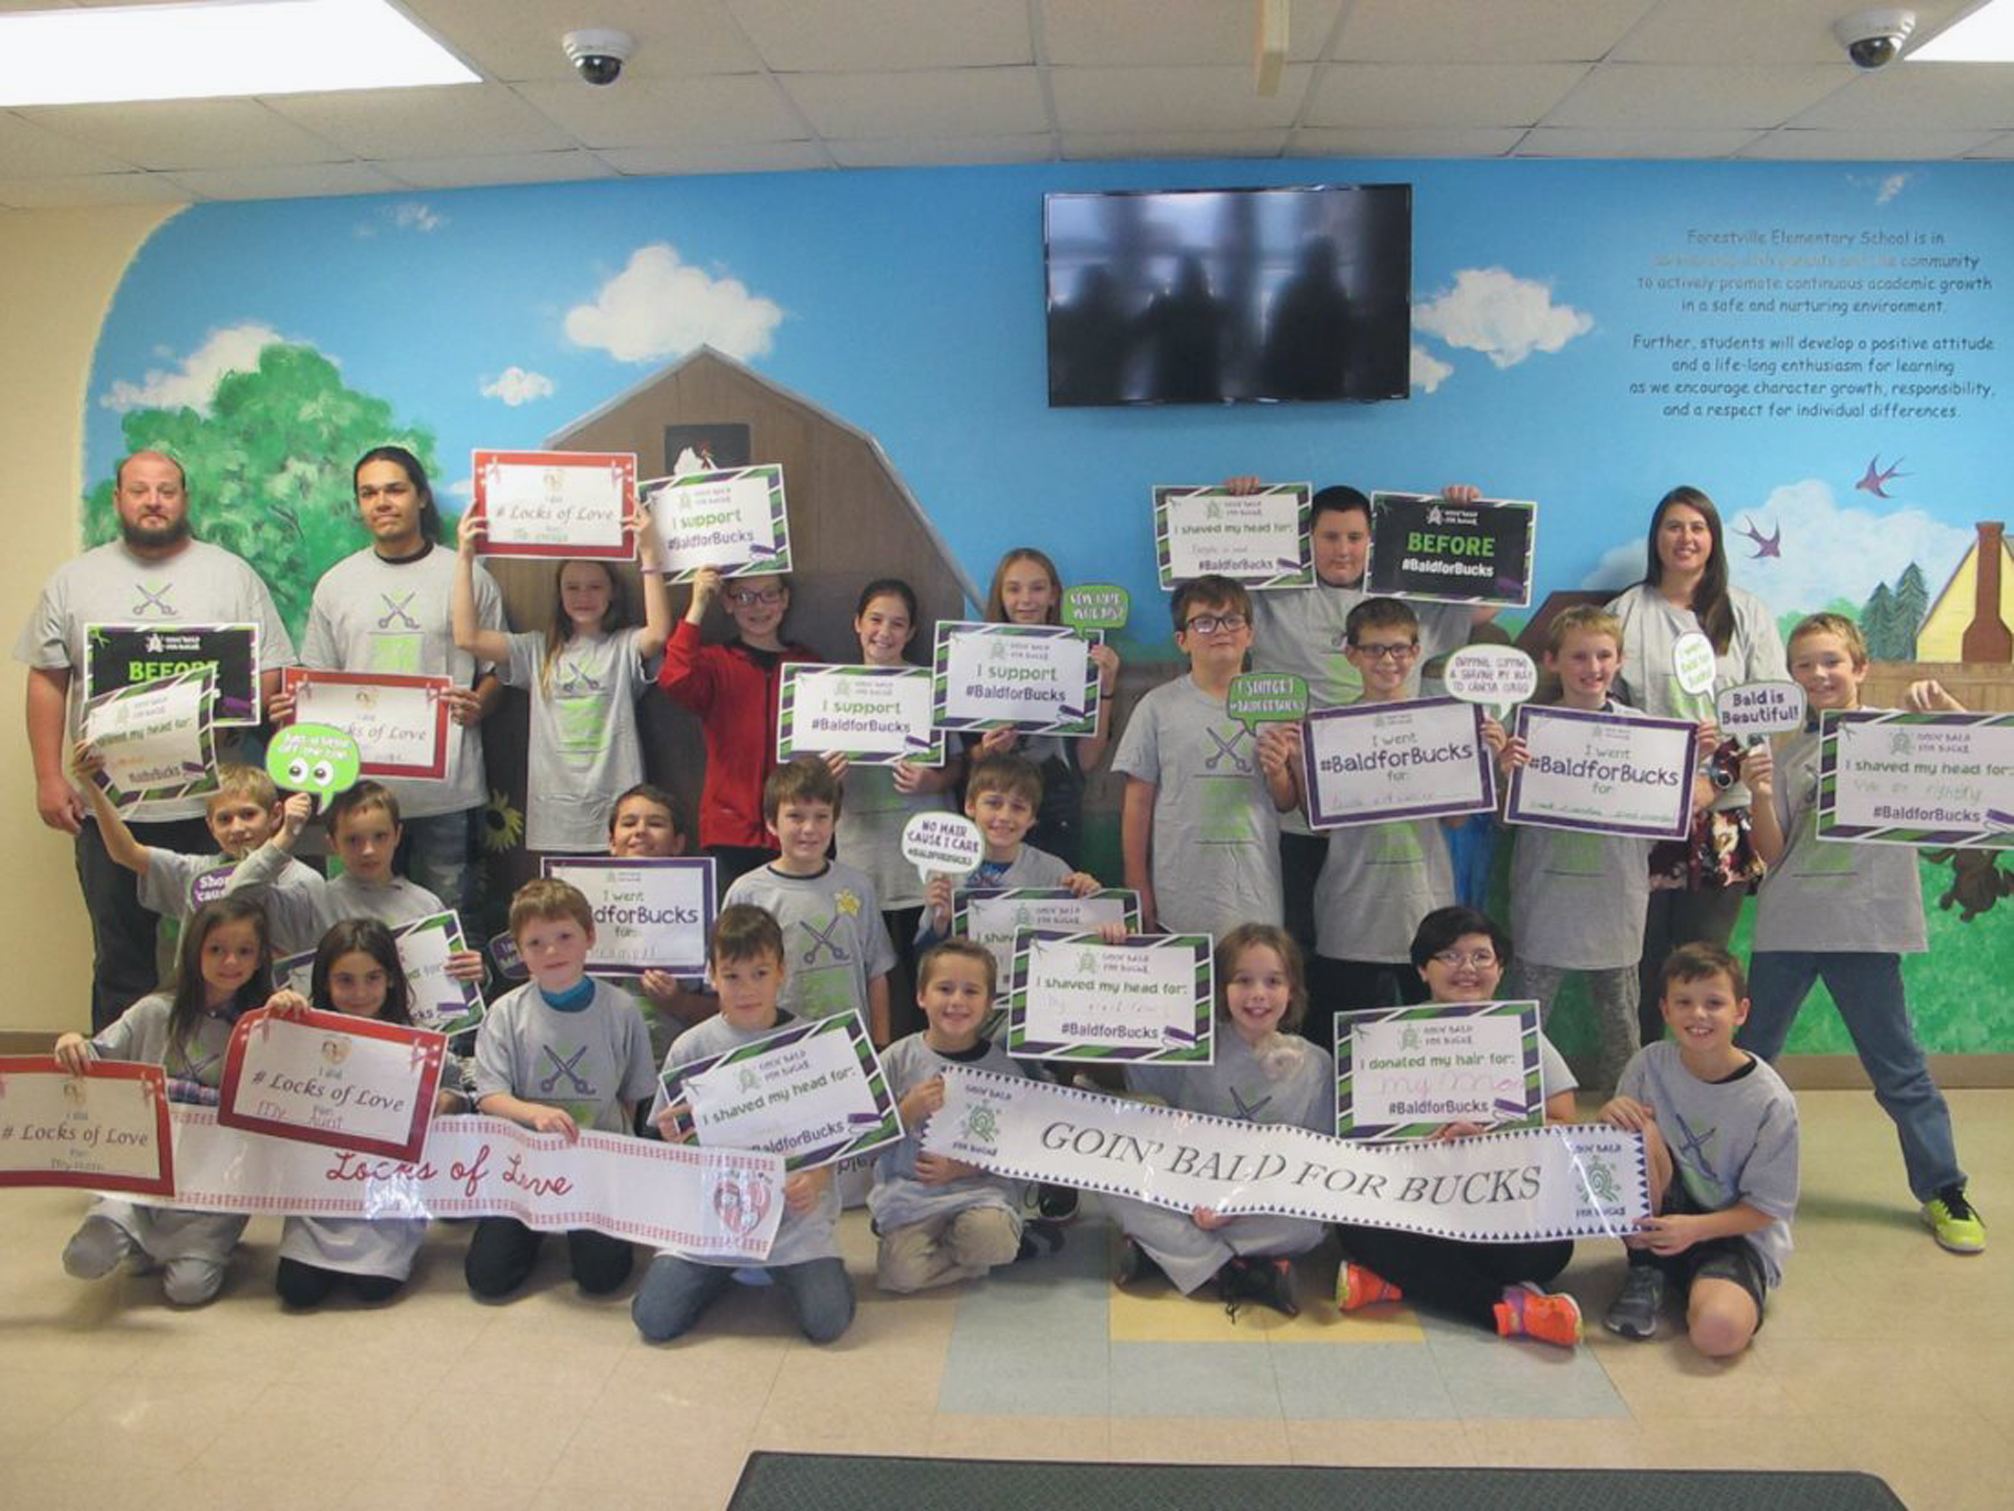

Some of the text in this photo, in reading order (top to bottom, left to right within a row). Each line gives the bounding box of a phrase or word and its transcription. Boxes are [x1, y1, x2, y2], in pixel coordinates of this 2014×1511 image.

[1772, 229, 1855, 247] Elementary
[1860, 230, 1909, 246] School
[1914, 230, 1927, 245] is
[1931, 231, 1945, 246] in
[1902, 255, 1980, 271] community
[1657, 277, 1714, 293] actively
[1720, 277, 1782, 293] promote
[1786, 277, 1863, 291] continuous
[1867, 276, 1936, 291] academic
[1940, 276, 1993, 294] growth
[1681, 299, 1695, 312] in
[1701, 302, 1708, 312] a
[1712, 298, 1745, 312] safe
[1750, 299, 1775, 312] and
[1780, 299, 1848, 316] nurturing
[1700, 335, 1765, 350] students
[1769, 336, 1794, 350] will
[1799, 336, 1854, 354] develop
[1858, 341, 1867, 351] a
[1872, 338, 1929, 354] positive
[1932, 336, 1994, 351] attitude
[1671, 357, 1955, 377] and a life-long enthusiasm for learning
[1629, 383, 1645, 395] as
[1650, 383, 1670, 394] we
[1675, 382, 1750, 398] encourage
[1753, 381, 1826, 396] character
[1662, 402, 1690, 417] and
[1693, 405, 1702, 416] a
[1706, 404, 1763, 420] respect
[1769, 402, 1792, 417] for
[1797, 403, 1865, 418] individual
[510, 503, 551, 521] Locks
[557, 507, 573, 523] of
[577, 506, 615, 520] Love
[680, 508, 743, 529] support
[1180, 523, 1222, 535] shaved
[1225, 525, 1242, 536] my
[1243, 522, 1271, 533] head
[1406, 531, 1495, 558] BEFORE
[1402, 557, 1495, 578] #BaldforBucks
[977, 663, 1058, 682] I support
[966, 684, 1067, 702] #BaldforBucks
[1732, 689, 1785, 707] Bald is
[834, 701, 901, 715] support
[1721, 704, 1799, 725] Beautiful!
[812, 719, 911, 733] #BaldforBucks
[1382, 732, 1419, 746] went
[1320, 742, 1473, 774] #BaldforBucks
[1585, 744, 1631, 760] I went
[1527, 755, 1680, 787] #BaldforBucks
[1855, 759, 1911, 773] shaved
[1914, 761, 1938, 776] my
[1941, 760, 1981, 775] head
[1873, 805, 1981, 823] #BaldforBucks
[921, 820, 968, 838] NO HAIR
[907, 829, 942, 848] CAUSE
[951, 838, 979, 854] CARE
[611, 890, 646, 903] went
[1037, 976, 1041, 988] I
[1045, 976, 1095, 991] shaved
[1098, 980, 1121, 995] my
[1123, 979, 1158, 995] head
[1060, 1022, 1159, 1040] #BaldforBucks
[1369, 1054, 1426, 1071] donated
[1429, 1057, 1452, 1069] my
[1455, 1052, 1485, 1066] hair
[252, 1070, 405, 1112] # Locks of Love
[702, 1114, 708, 1126] I
[712, 1097, 765, 1123] shaved
[767, 1090, 790, 1107] my
[791, 1074, 828, 1097] head
[1388, 1098, 1490, 1116] #BaldforBucks
[2, 1121, 149, 1148] # Locks of Love
[449, 1144, 490, 1198] of
[502, 1153, 574, 1197] Love
[1040, 1120, 1542, 1206] GOIN' BALD FOR BUCKS
